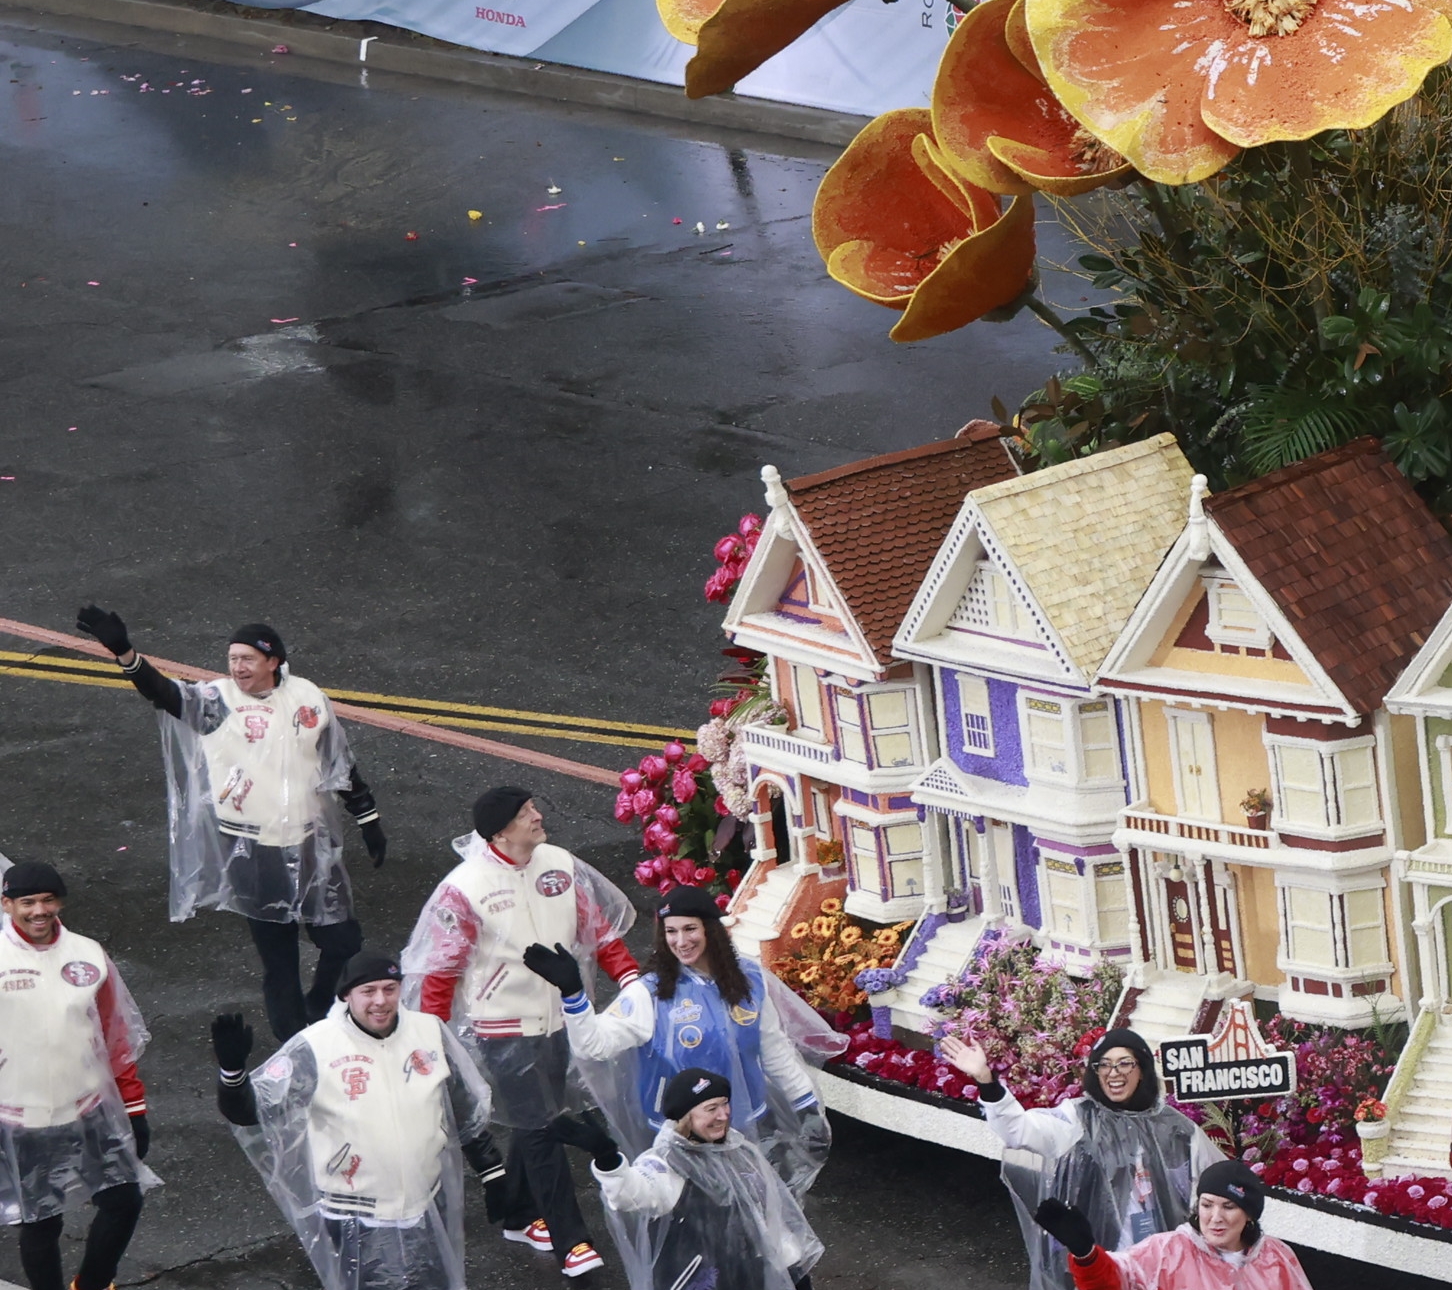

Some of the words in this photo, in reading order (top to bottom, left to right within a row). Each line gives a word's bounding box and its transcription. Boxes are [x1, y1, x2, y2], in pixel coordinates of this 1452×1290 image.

[475, 6, 527, 28] HONDA
[1166, 1045, 1204, 1071] SAN
[1180, 1063, 1283, 1093] FRANCISCO
